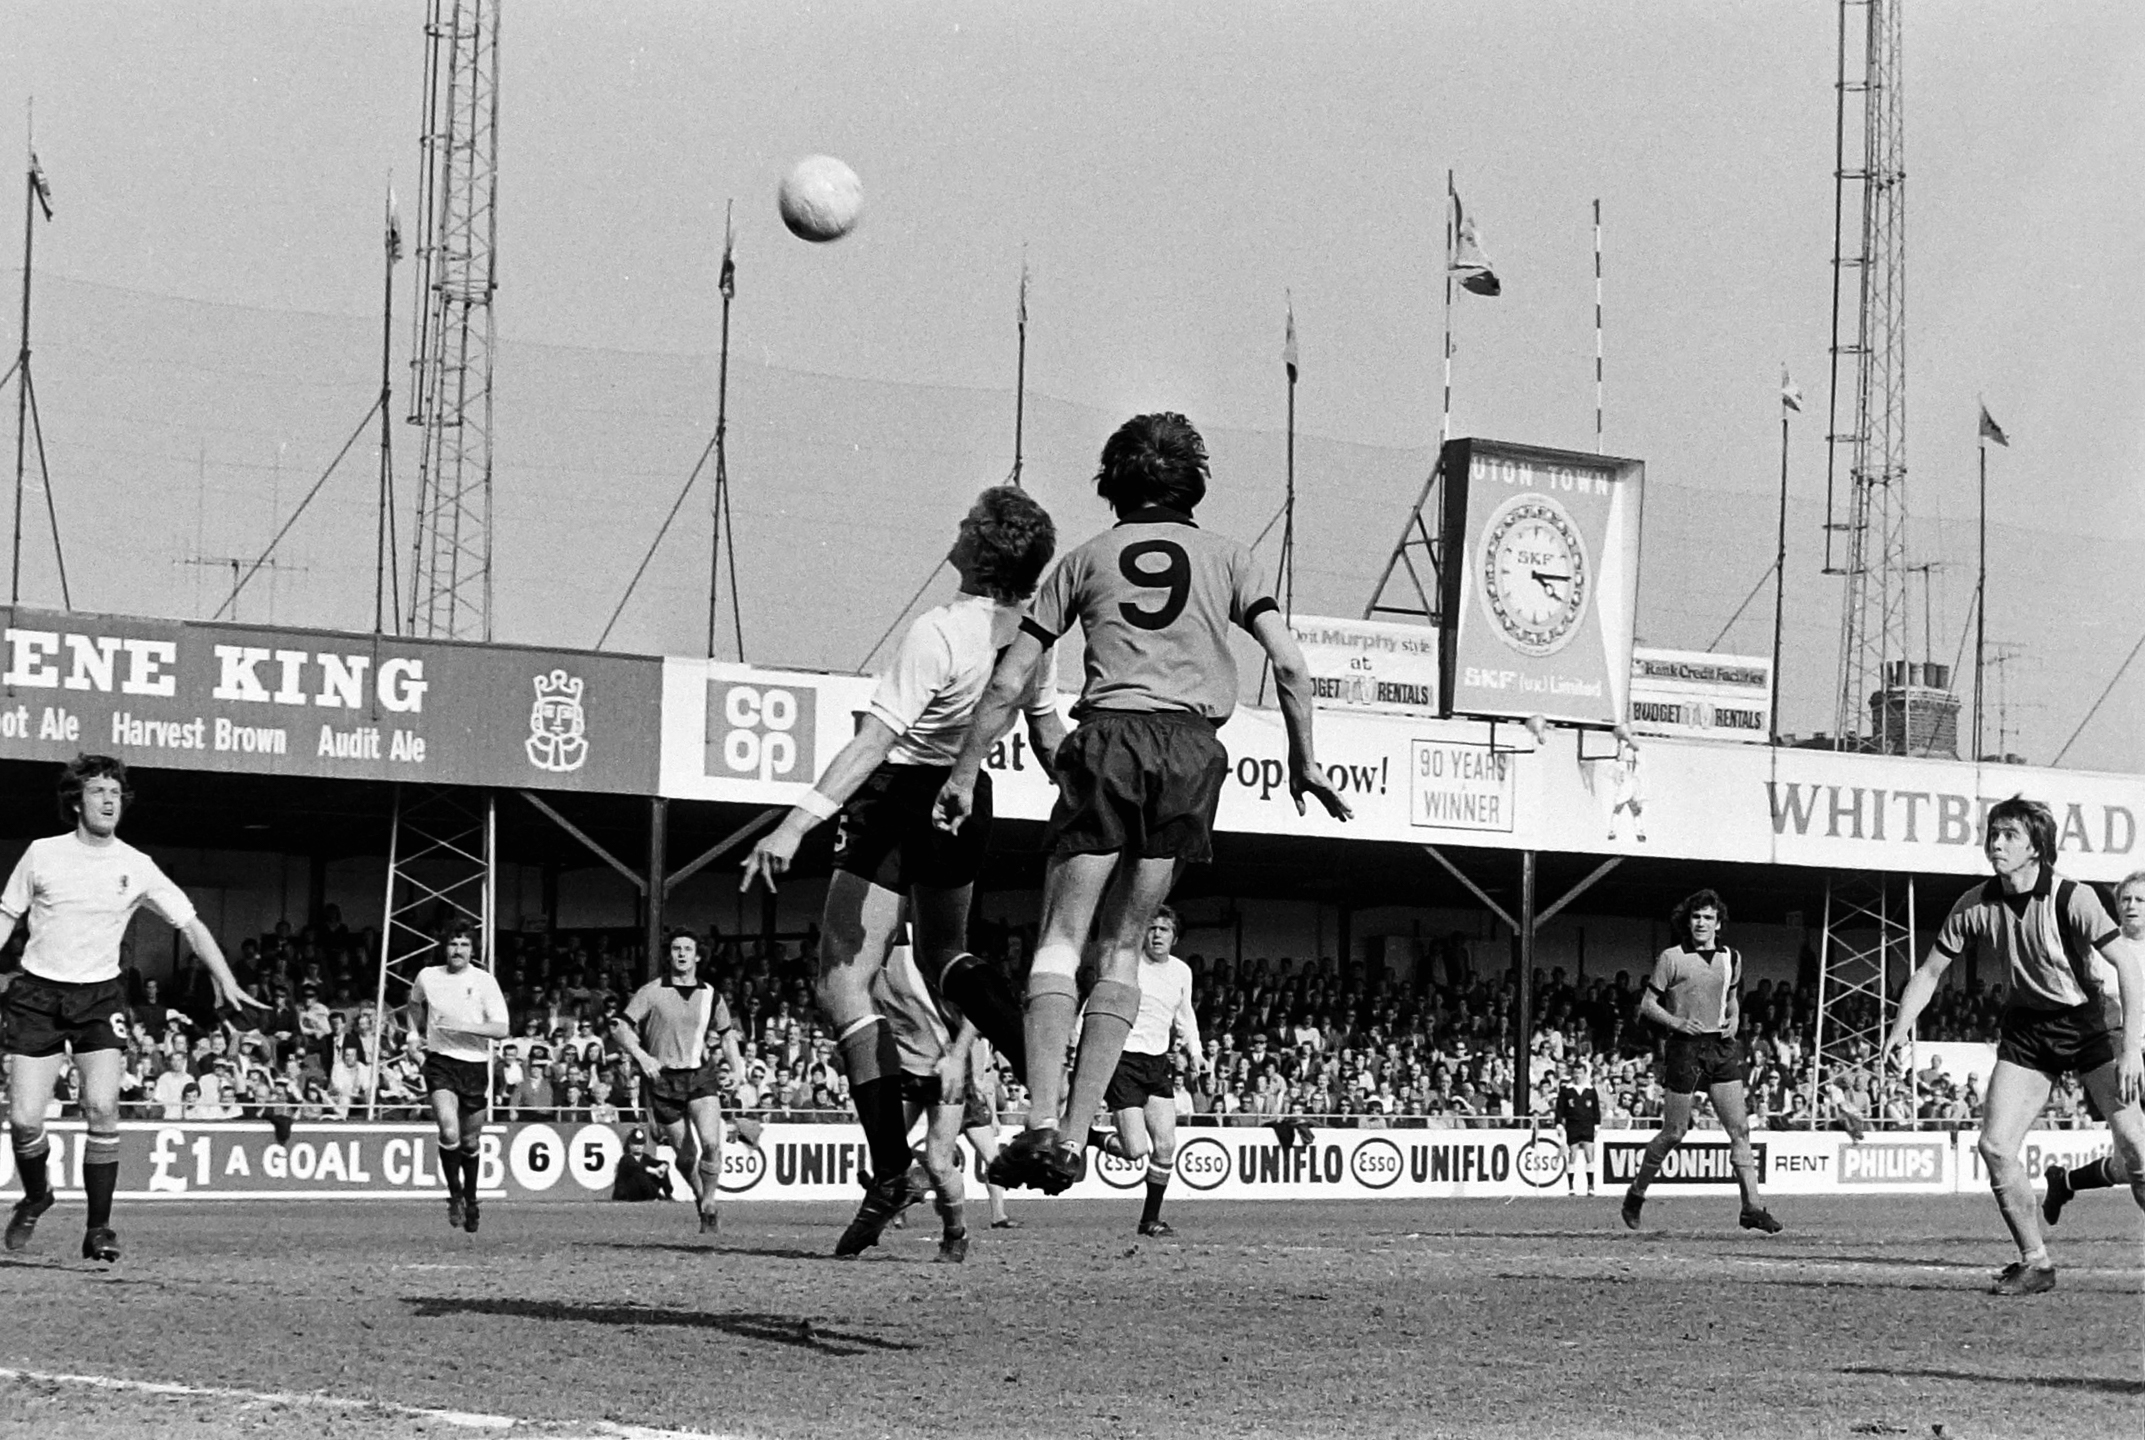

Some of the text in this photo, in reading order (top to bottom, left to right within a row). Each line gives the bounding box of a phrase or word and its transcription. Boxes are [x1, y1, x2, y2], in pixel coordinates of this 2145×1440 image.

[1547, 464, 1608, 496] TOWN
[1517, 550, 1555, 566] SKF
[1118, 539, 1192, 631] 9
[212, 644, 429, 713] KING
[1350, 656, 1372, 671] at
[1464, 666, 1517, 690] SKF
[1377, 681, 1430, 706] RENTALS
[1632, 701, 1681, 724] BUDGET
[1715, 708, 1762, 730] RENTALS
[39, 706, 80, 742] Ale
[111, 711, 207, 750] Harvest
[214, 717, 287, 755] Brown
[317, 724, 382, 761] Audit
[389, 729, 427, 763] Ale
[1316, 756, 1389, 796] ow!
[1420, 748, 1507, 782] 90 YEARS
[1424, 790, 1501, 825] WINNER
[1763, 781, 2137, 855] WHITBAD
[109, 1011, 129, 1039] 6
[225, 1145, 251, 1176] A
[262, 1140, 371, 1183] GOAL
[382, 1133, 506, 1190] CLB
[528, 1141, 550, 1173] 6
[583, 1142, 605, 1173] 5
[724, 1155, 757, 1174] sso
[775, 1143, 867, 1186] UNIF
[1238, 1143, 1344, 1185] UNIFLO
[1411, 1143, 1510, 1183] UNIFLO
[1608, 1148, 1760, 1179] VISONHI
[1775, 1155, 1830, 1172] RENT
[1844, 1148, 1935, 1178] PHILIPS
